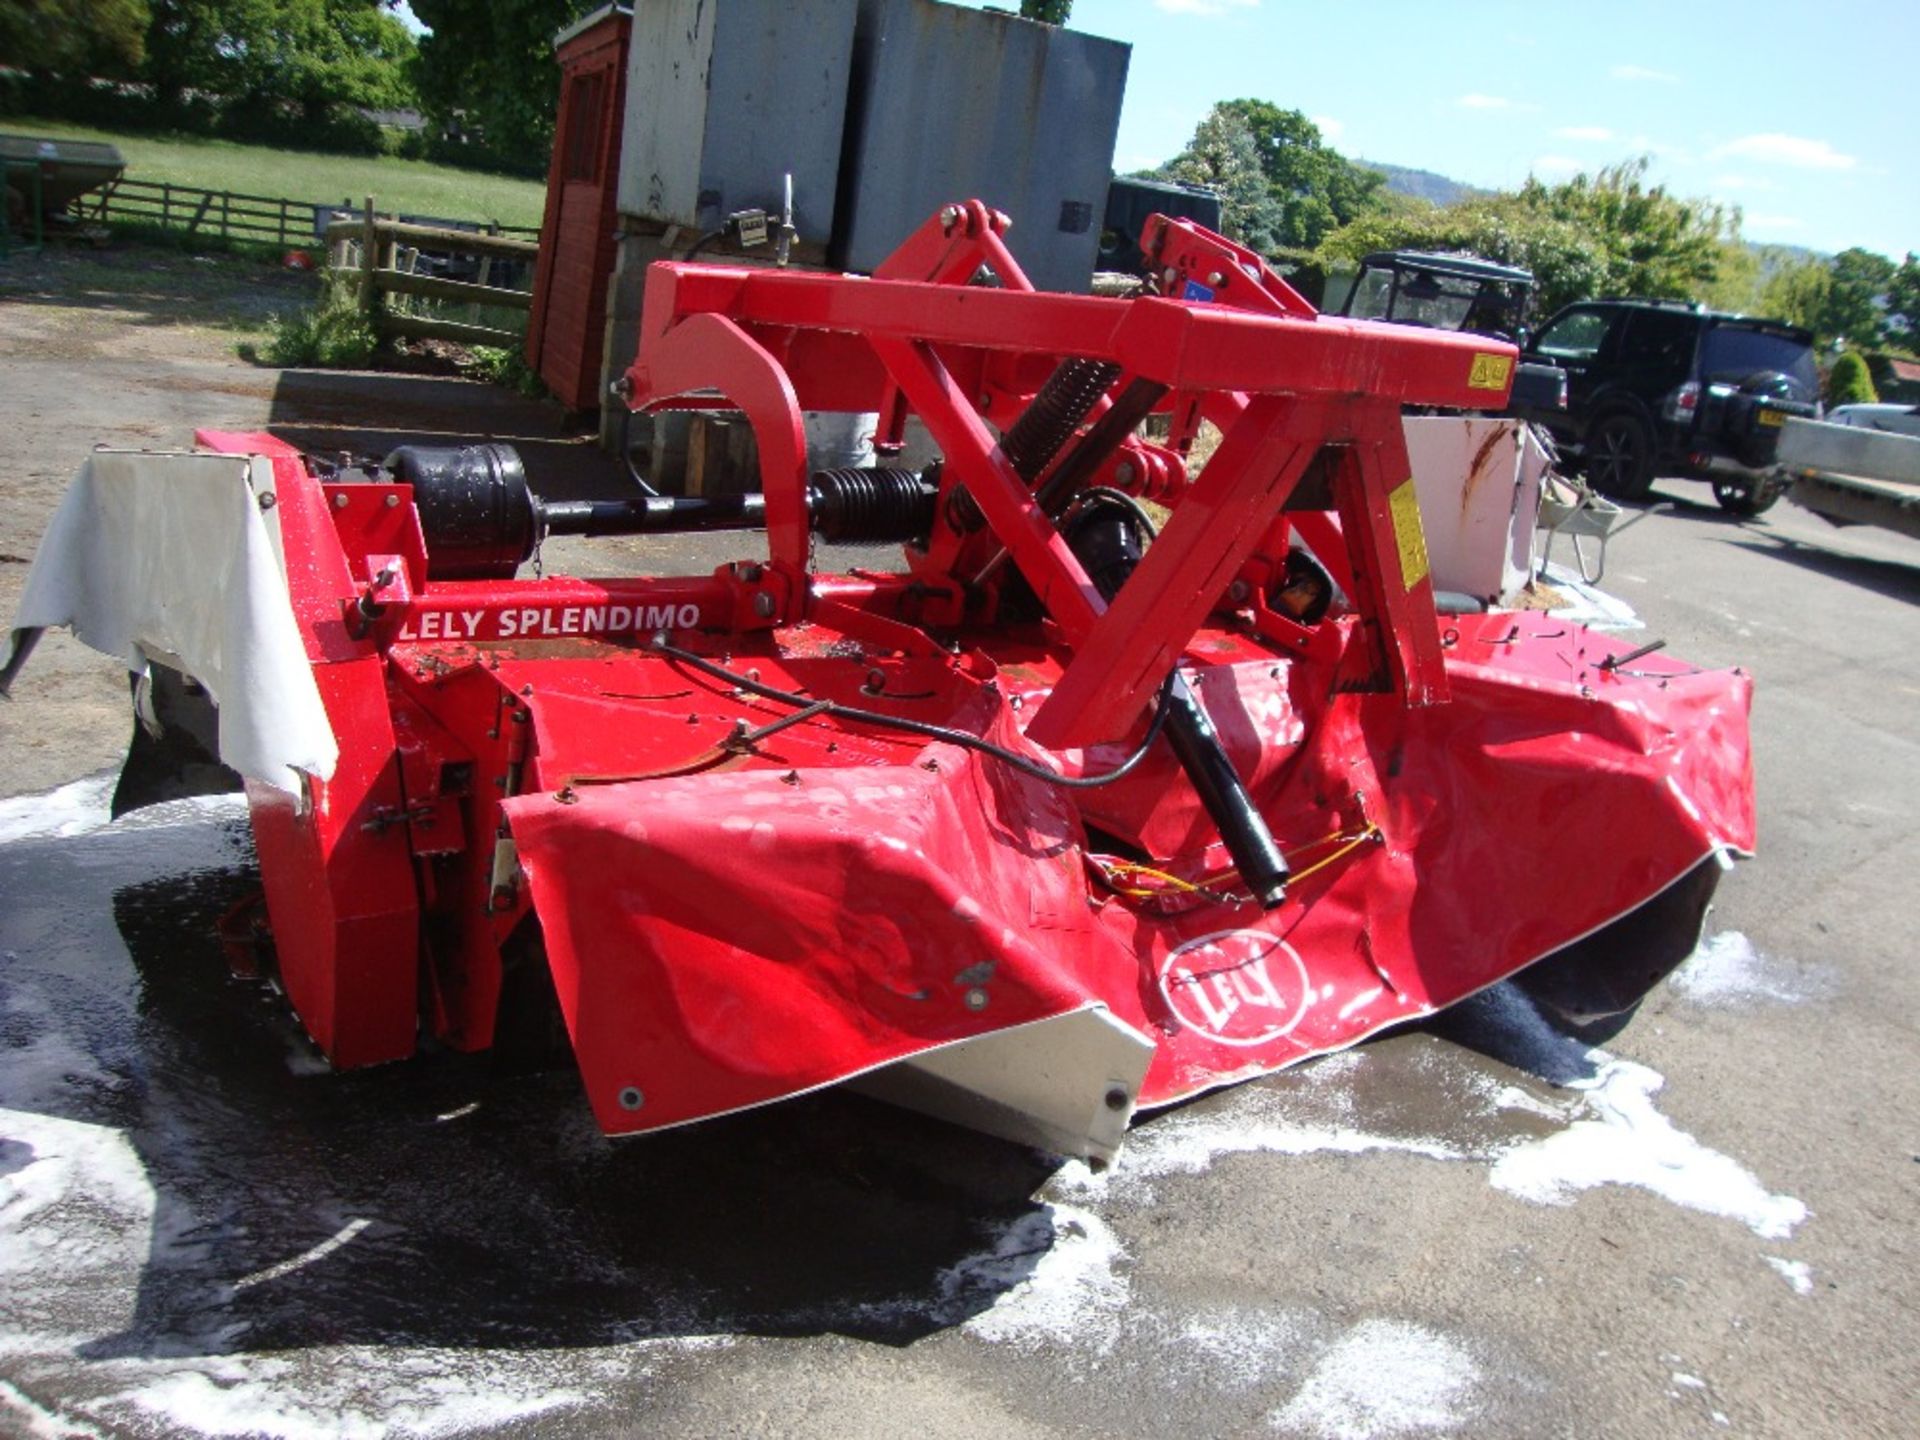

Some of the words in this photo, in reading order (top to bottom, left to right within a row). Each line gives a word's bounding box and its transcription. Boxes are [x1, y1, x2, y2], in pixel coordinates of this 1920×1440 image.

[399, 610, 485, 640] LELY
[499, 604, 700, 636] SPLENDIMO
[1176, 942, 1286, 1033] LELY
